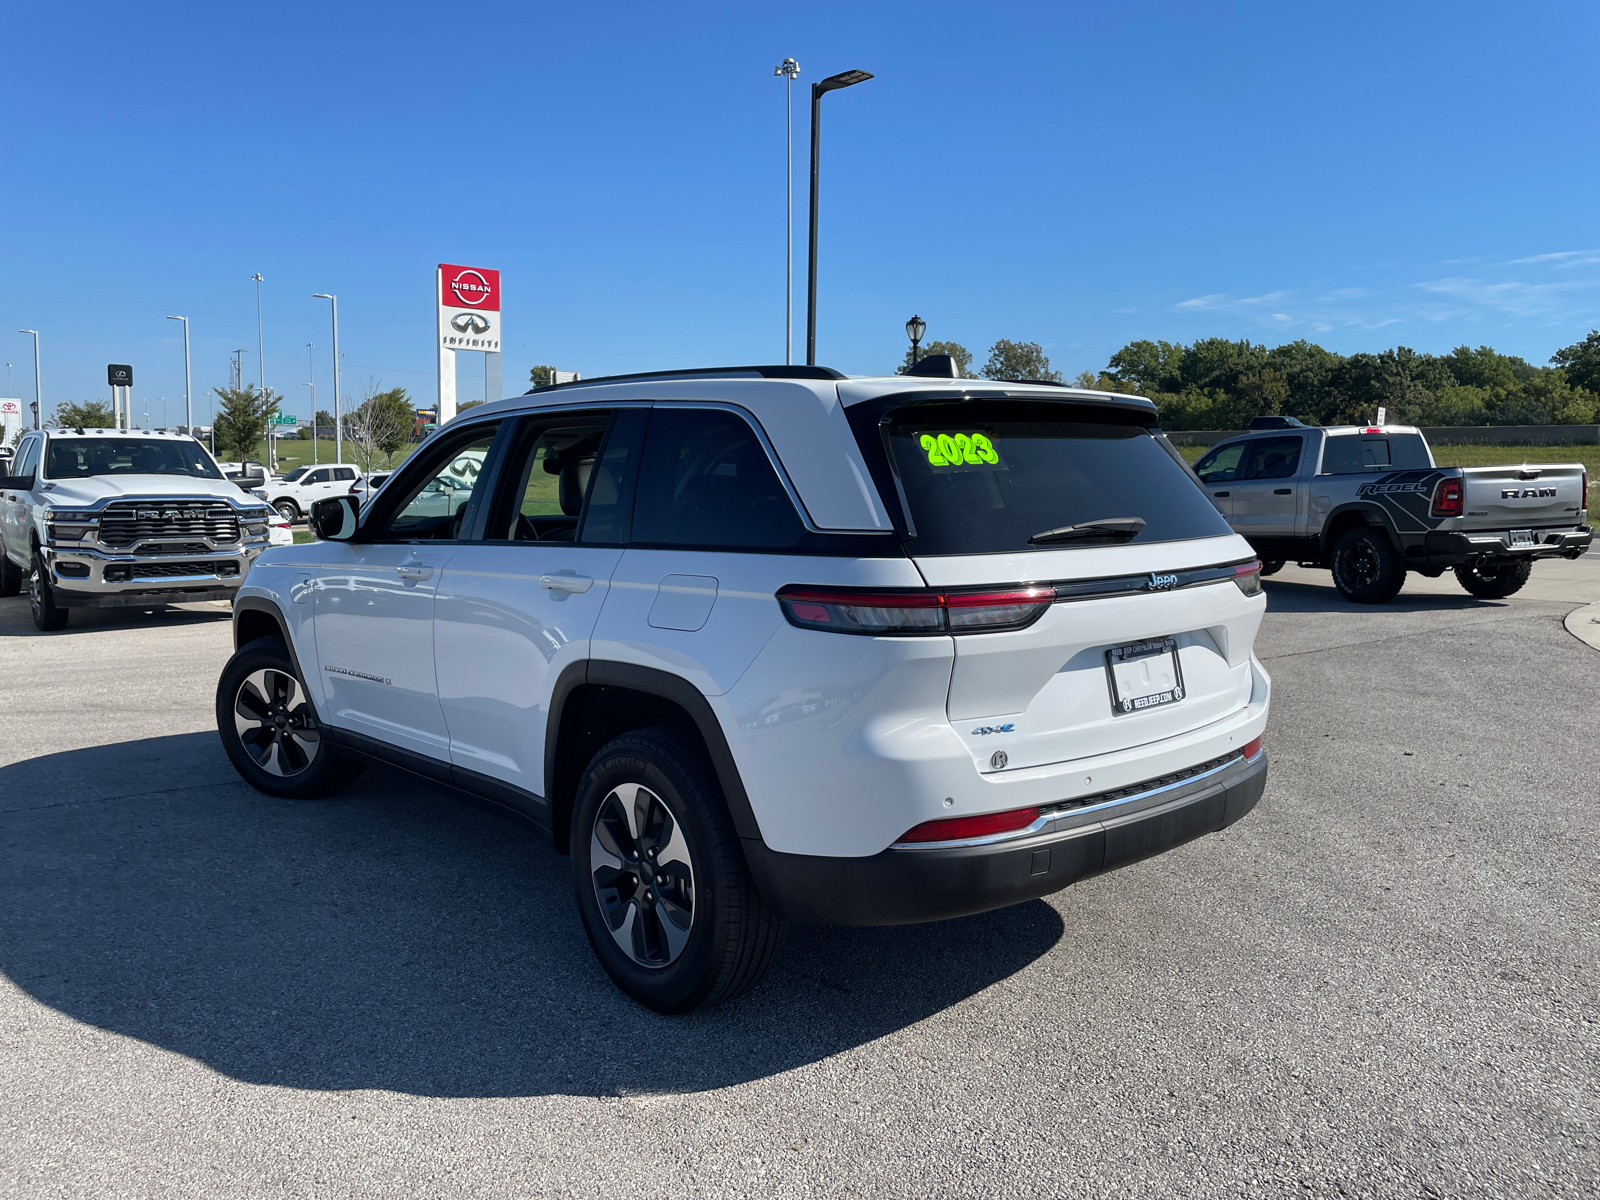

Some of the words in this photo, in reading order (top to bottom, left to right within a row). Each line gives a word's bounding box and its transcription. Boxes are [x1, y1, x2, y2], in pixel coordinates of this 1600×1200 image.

[451, 282, 491, 293] NISSAN
[443, 336, 499, 349] INFINITI
[920, 433, 999, 467] 2023
[1355, 482, 1428, 496] REBEL
[1501, 486, 1557, 499] RAM
[138, 509, 205, 520] RAM
[1147, 572, 1178, 591] Jeep
[1112, 648, 1123, 656] REED
[1123, 646, 1132, 654] JEEP
[1134, 692, 1173, 709] REEDJEEP.COM
